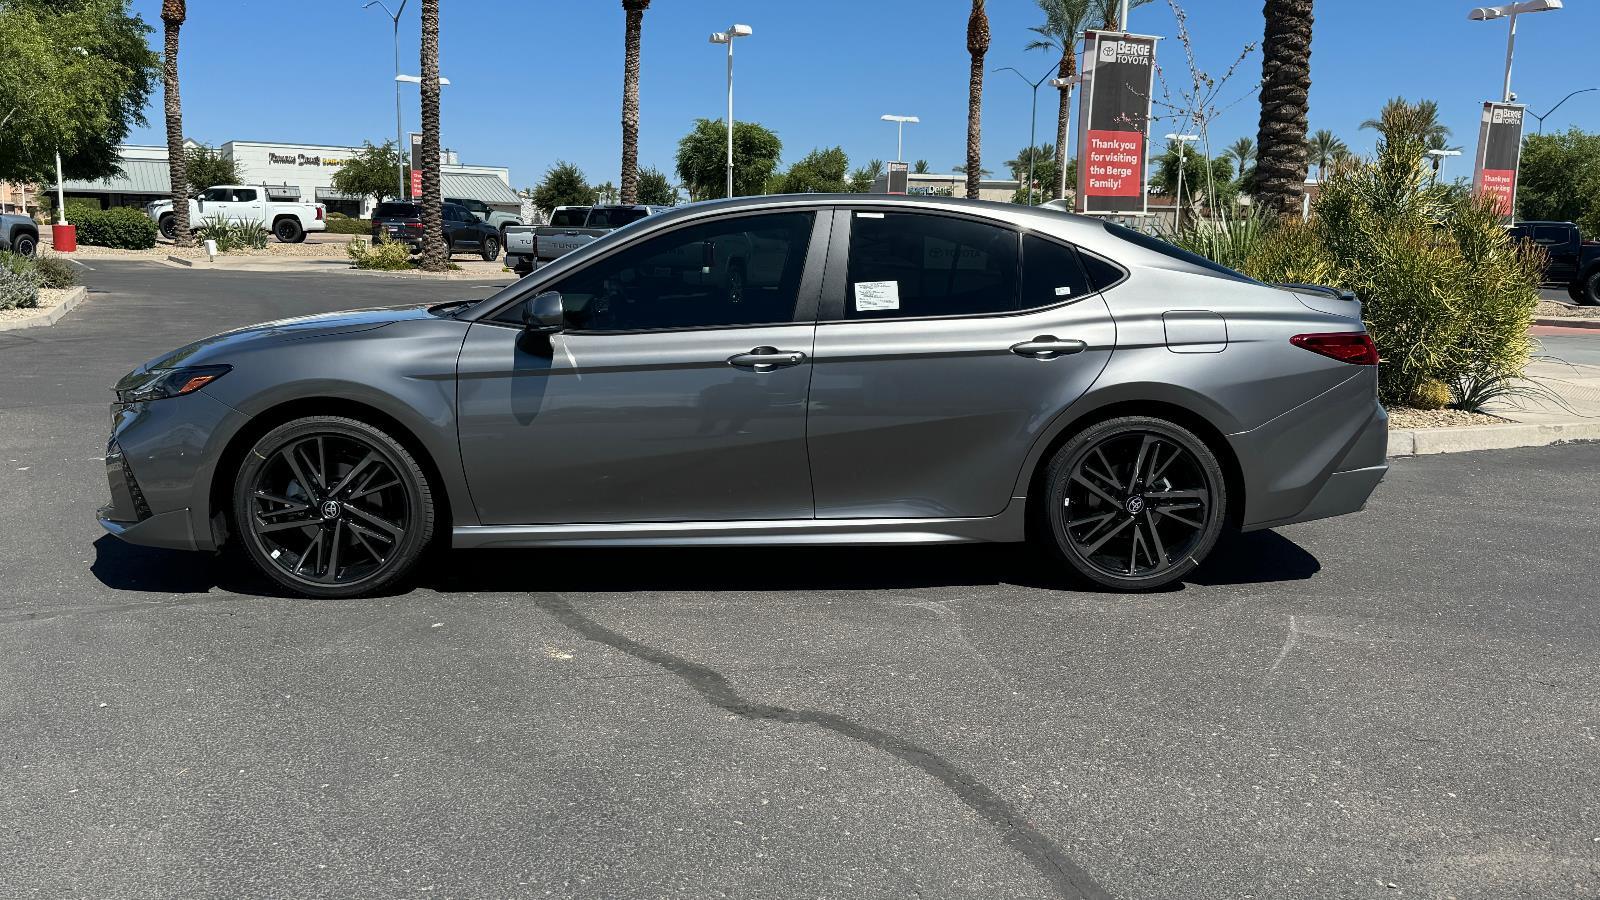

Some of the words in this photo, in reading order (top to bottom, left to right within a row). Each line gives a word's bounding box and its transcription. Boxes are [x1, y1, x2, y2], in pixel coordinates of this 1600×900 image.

[1117, 41, 1150, 55] BERGE
[1117, 55, 1148, 65] TOYOTA
[1092, 139, 1119, 149] Thank
[1119, 142, 1136, 151] you
[1091, 152, 1104, 161] for
[1105, 153, 1137, 164] visiting
[1090, 165, 1105, 174] the
[1107, 166, 1132, 177] Berge
[1090, 179, 1121, 190] Family!
